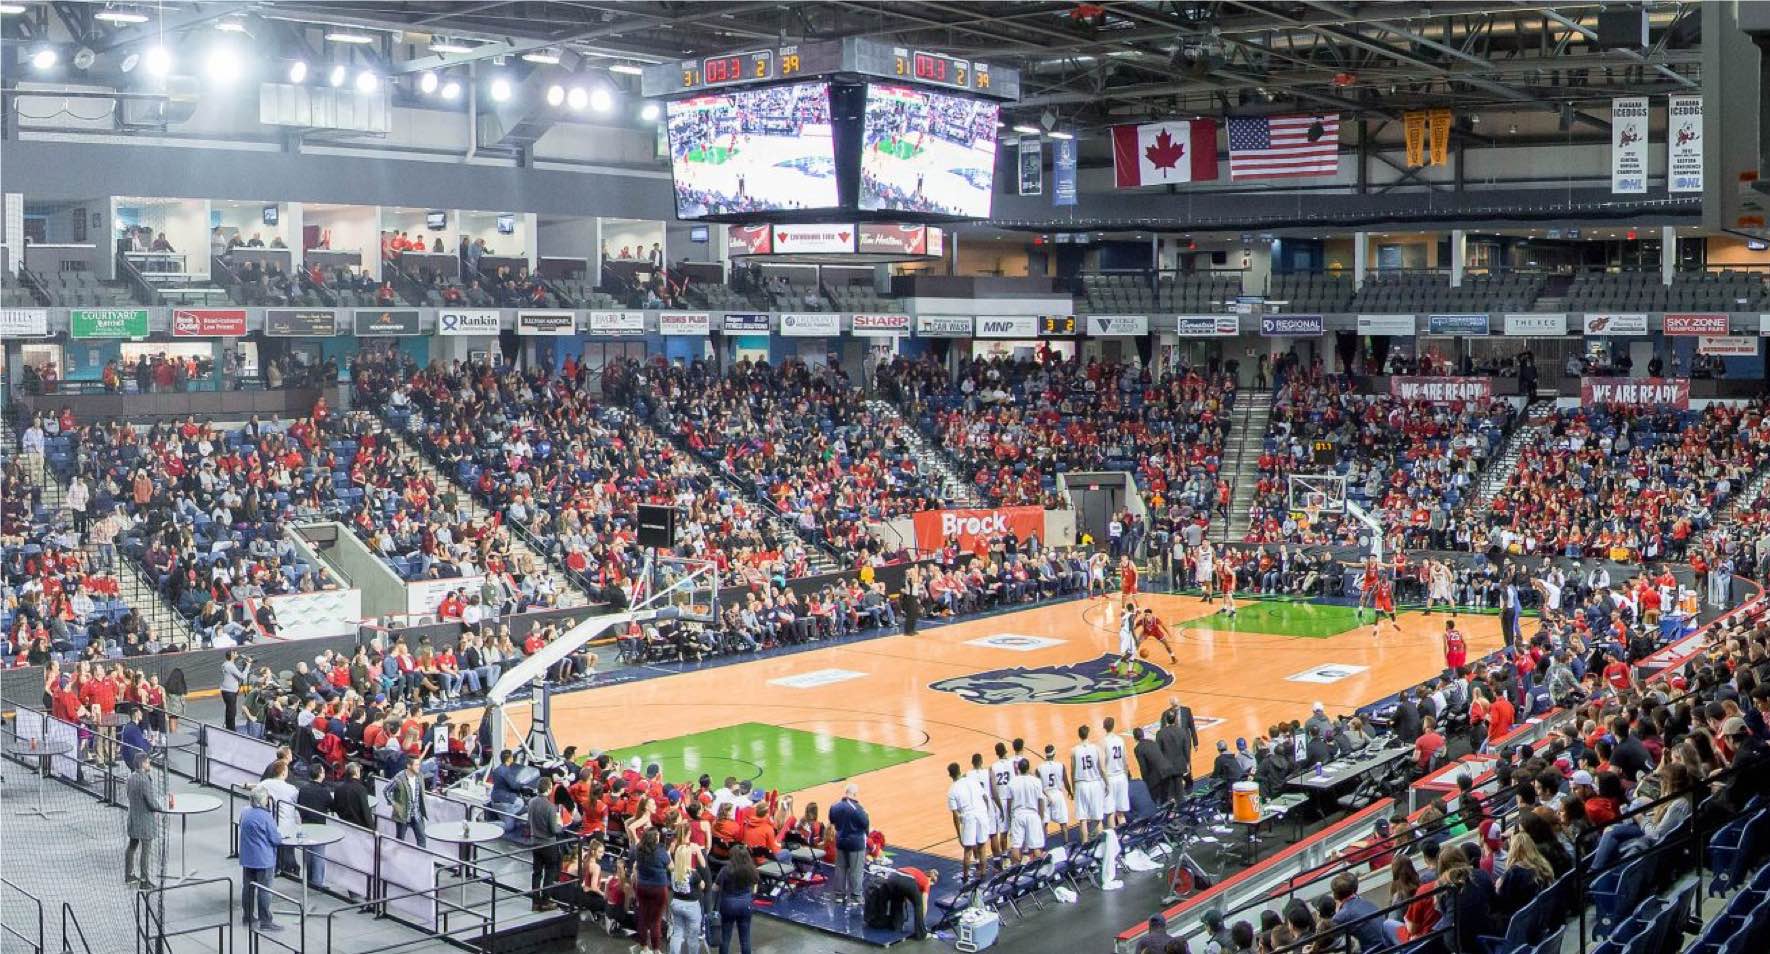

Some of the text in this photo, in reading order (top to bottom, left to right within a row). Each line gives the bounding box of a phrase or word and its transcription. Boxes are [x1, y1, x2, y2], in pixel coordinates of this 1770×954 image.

[757, 60, 766, 78] 2
[783, 56, 800, 75] 39
[896, 57, 911, 75] 31
[683, 70, 699, 87] 31
[956, 69, 965, 85] 2
[1613, 108, 1647, 117] ICEDOGS
[81, 312, 137, 321] COURTYARD
[459, 315, 497, 325] Rankin
[854, 316, 908, 325] SHARP
[1666, 318, 1726, 327] SKY ZONE
[984, 321, 1013, 332] MNP
[1047, 319, 1053, 331] 3
[1276, 320, 1320, 328] REGIONAL
[1401, 383, 1482, 401] WE ARE READY
[1592, 385, 1678, 403] WE ARE READY
[941, 512, 1007, 535] Brock
[1081, 755, 1092, 770] 15
[996, 771, 1009, 785] 23
[1048, 773, 1054, 787] 5
